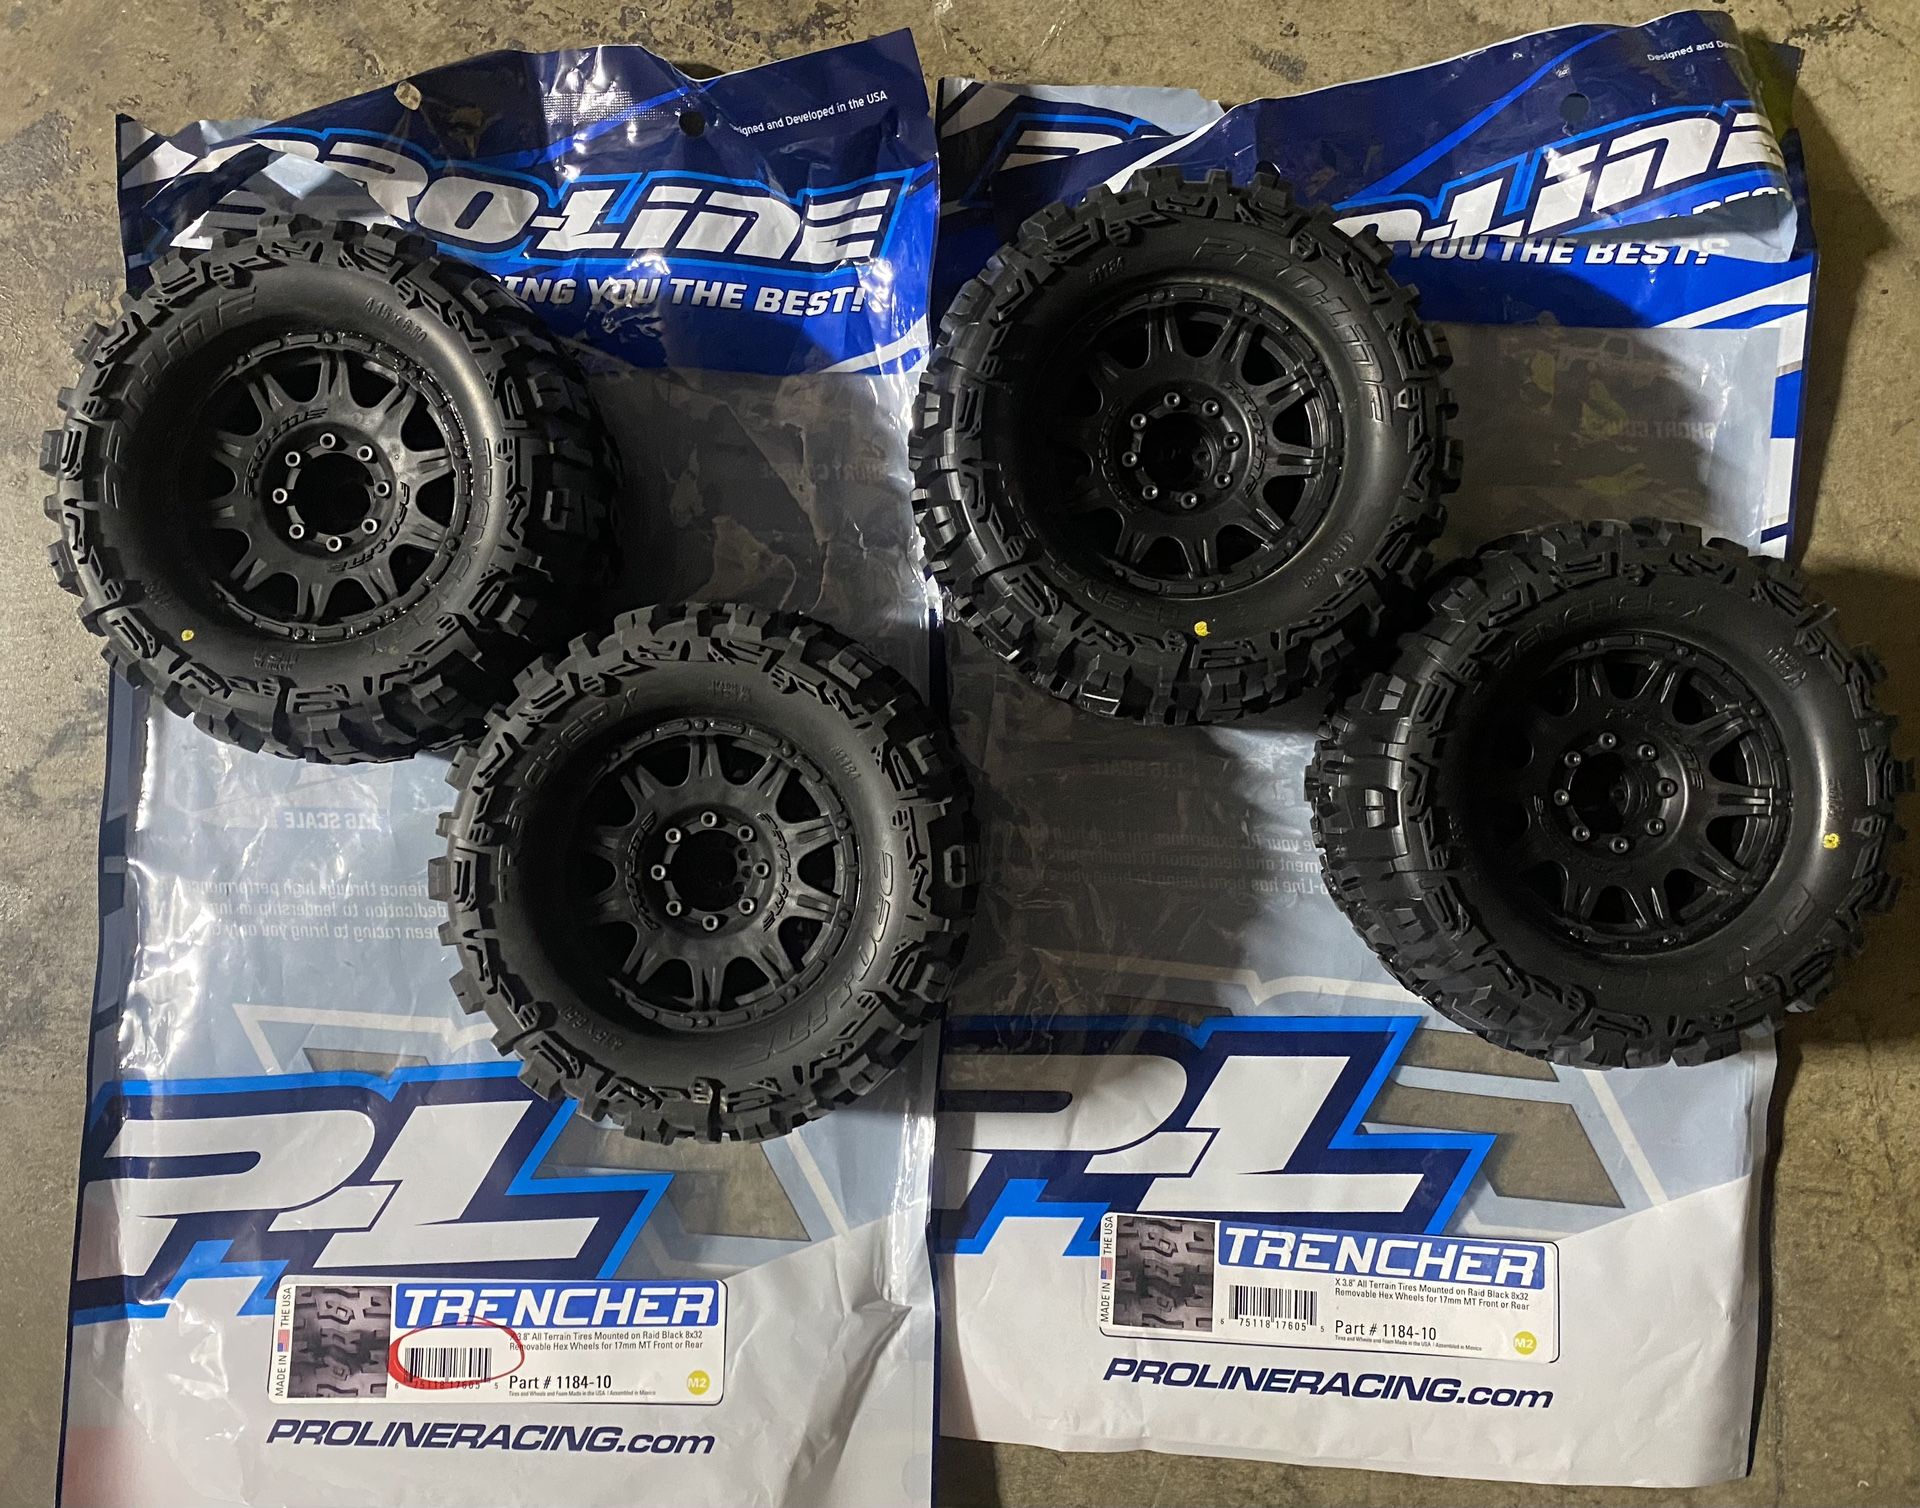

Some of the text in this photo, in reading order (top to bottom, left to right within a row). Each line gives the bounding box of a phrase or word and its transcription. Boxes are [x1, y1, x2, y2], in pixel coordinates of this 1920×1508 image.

[1647, 46, 1693, 61] Designed
[1696, 41, 1714, 51] and
[729, 90, 888, 137] igned and Developed in the USA
[170, 140, 892, 264] RO-LINE
[1410, 235, 1488, 260] YOU
[1500, 236, 1575, 264] THE
[497, 275, 867, 316] ING YOU THE BEST!
[1103, 1215, 1114, 1255] THE USA
[1224, 1227, 1536, 1287] TRENCHER
[1100, 1281, 1111, 1323] MADE IN
[1335, 1278, 1341, 1286] X
[1357, 1280, 1367, 1289] All
[1369, 1281, 1397, 1291] Terrain
[1398, 1283, 1417, 1292] Tires
[1419, 1284, 1453, 1295] Mounted
[1467, 1287, 1485, 1297] Raid
[1487, 1288, 1509, 1299] Black
[1511, 1292, 1529, 1301] 8x32
[1335, 1288, 1377, 1299] Removable
[1378, 1291, 1394, 1300] Hex
[1395, 1292, 1424, 1303] Wheels
[1426, 1294, 1437, 1303] for
[1439, 1295, 1462, 1305] 17mm
[1463, 1297, 1477, 1306] MT
[1478, 1298, 1498, 1308] Front
[1511, 1300, 1530, 1310] Rear
[280, 1286, 292, 1327] THE USA
[404, 1286, 711, 1327] TRENCHER
[532, 1332, 542, 1340] All
[544, 1332, 571, 1340] Terrain
[573, 1332, 592, 1340] Tires
[594, 1331, 629, 1340] Mounted
[643, 1331, 660, 1340] Raid
[662, 1331, 683, 1339] Black
[685, 1331, 703, 1339] 8x32
[1239, 1317, 1271, 1328] 75118
[1275, 1319, 1307, 1331] 17605
[1335, 1320, 1437, 1340] Part # 1184-10
[553, 1342, 568, 1351] Hex
[570, 1341, 599, 1350] Wheels
[601, 1341, 612, 1350] for
[614, 1342, 637, 1350] 17mm
[653, 1341, 673, 1350] Front
[685, 1341, 703, 1349] Rear
[1515, 1338, 1534, 1348] M2
[275, 1355, 287, 1397] MADE IN
[509, 1375, 612, 1389] Part # 1184-10
[687, 1378, 707, 1388] M2
[1103, 1357, 1554, 1409] PROLINERACING.com
[266, 1418, 716, 1455] PROLINERACING.com
